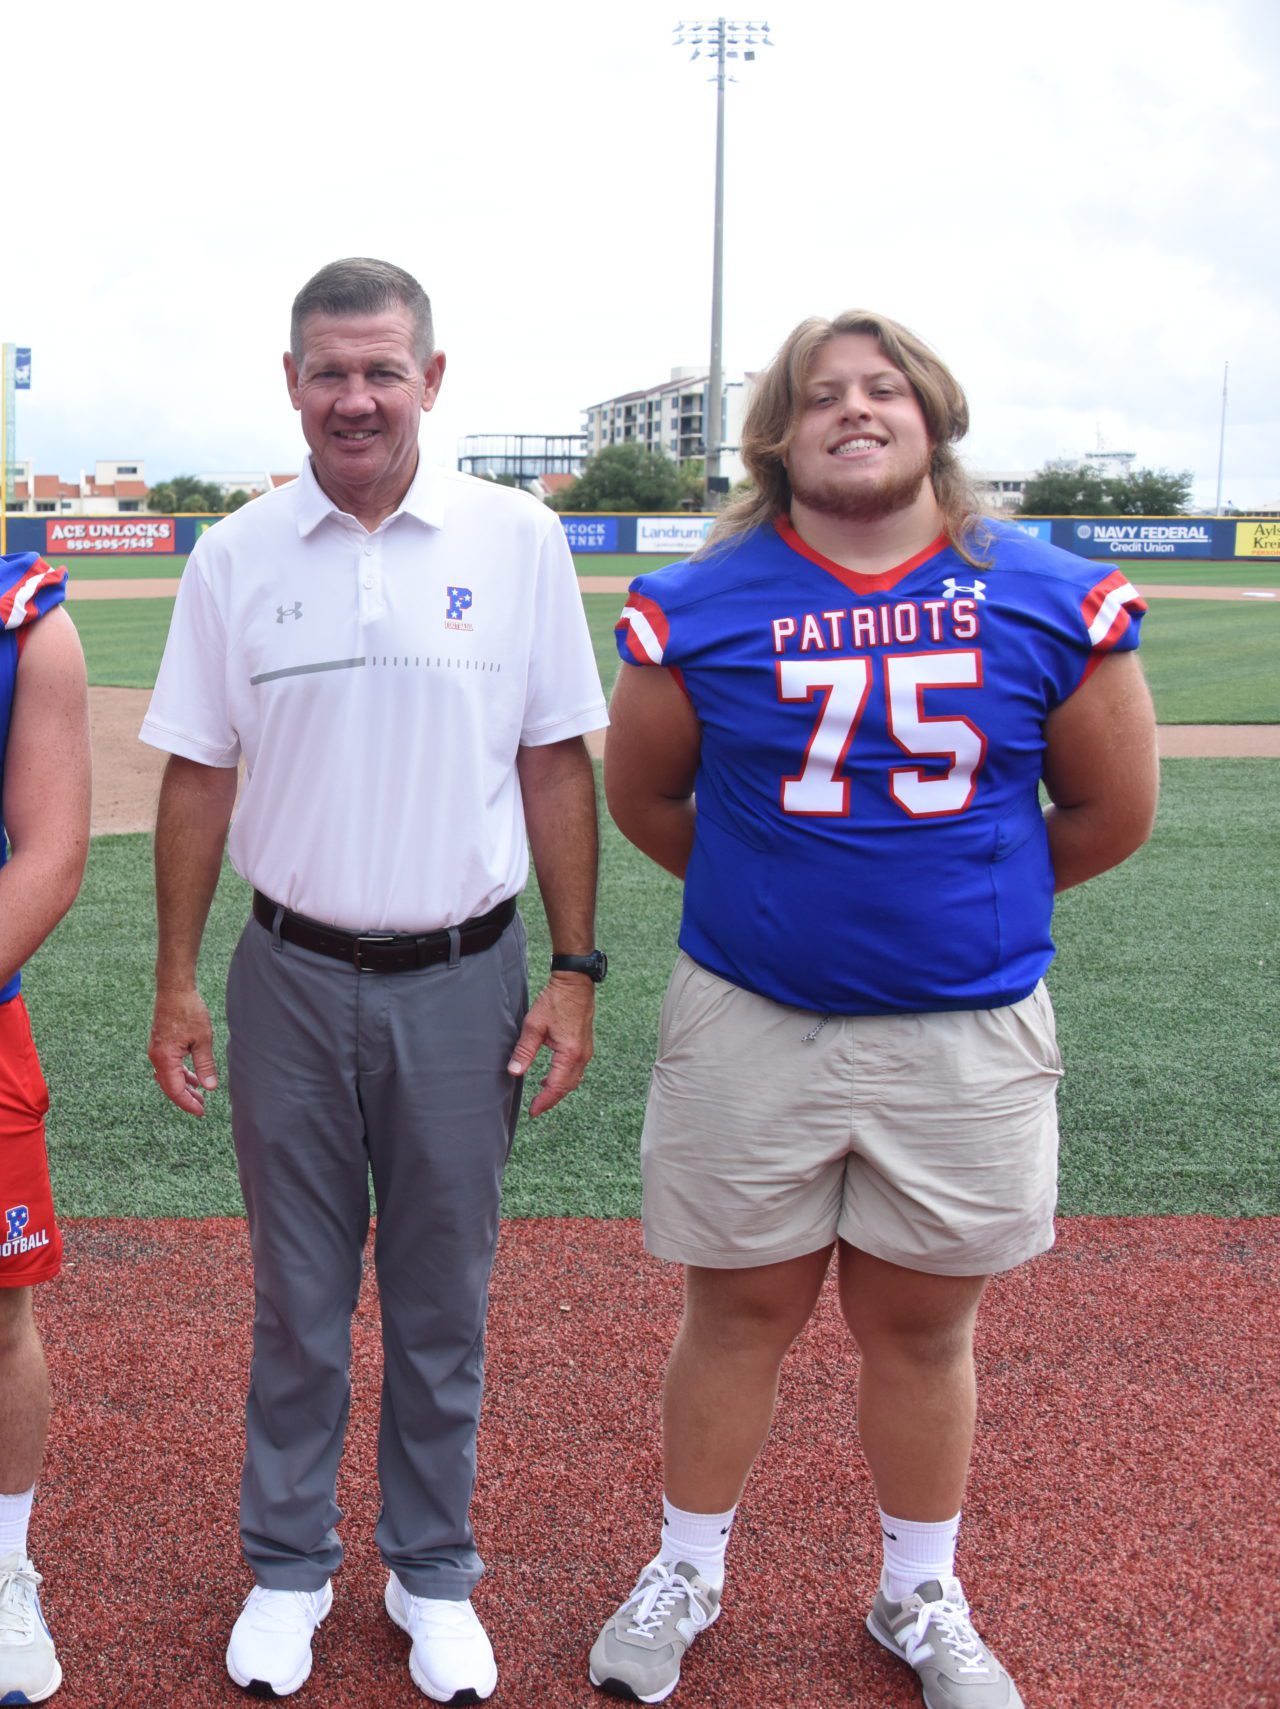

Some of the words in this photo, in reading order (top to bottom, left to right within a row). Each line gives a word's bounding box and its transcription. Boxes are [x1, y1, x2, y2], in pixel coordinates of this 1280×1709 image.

[51, 525, 86, 540] ACE
[89, 523, 170, 539] UNLOCKS
[642, 525, 703, 538] Landrum
[1094, 526, 1137, 539] NAVY
[1140, 526, 1209, 539] FEDERAL
[66, 538, 154, 551] 850-505-7545
[1110, 542, 1142, 552] Credit
[1144, 542, 1175, 553] Union
[446, 586, 472, 620] P
[772, 598, 980, 653] PATRIOTS
[775, 648, 988, 819] 75
[5, 1204, 30, 1242] P
